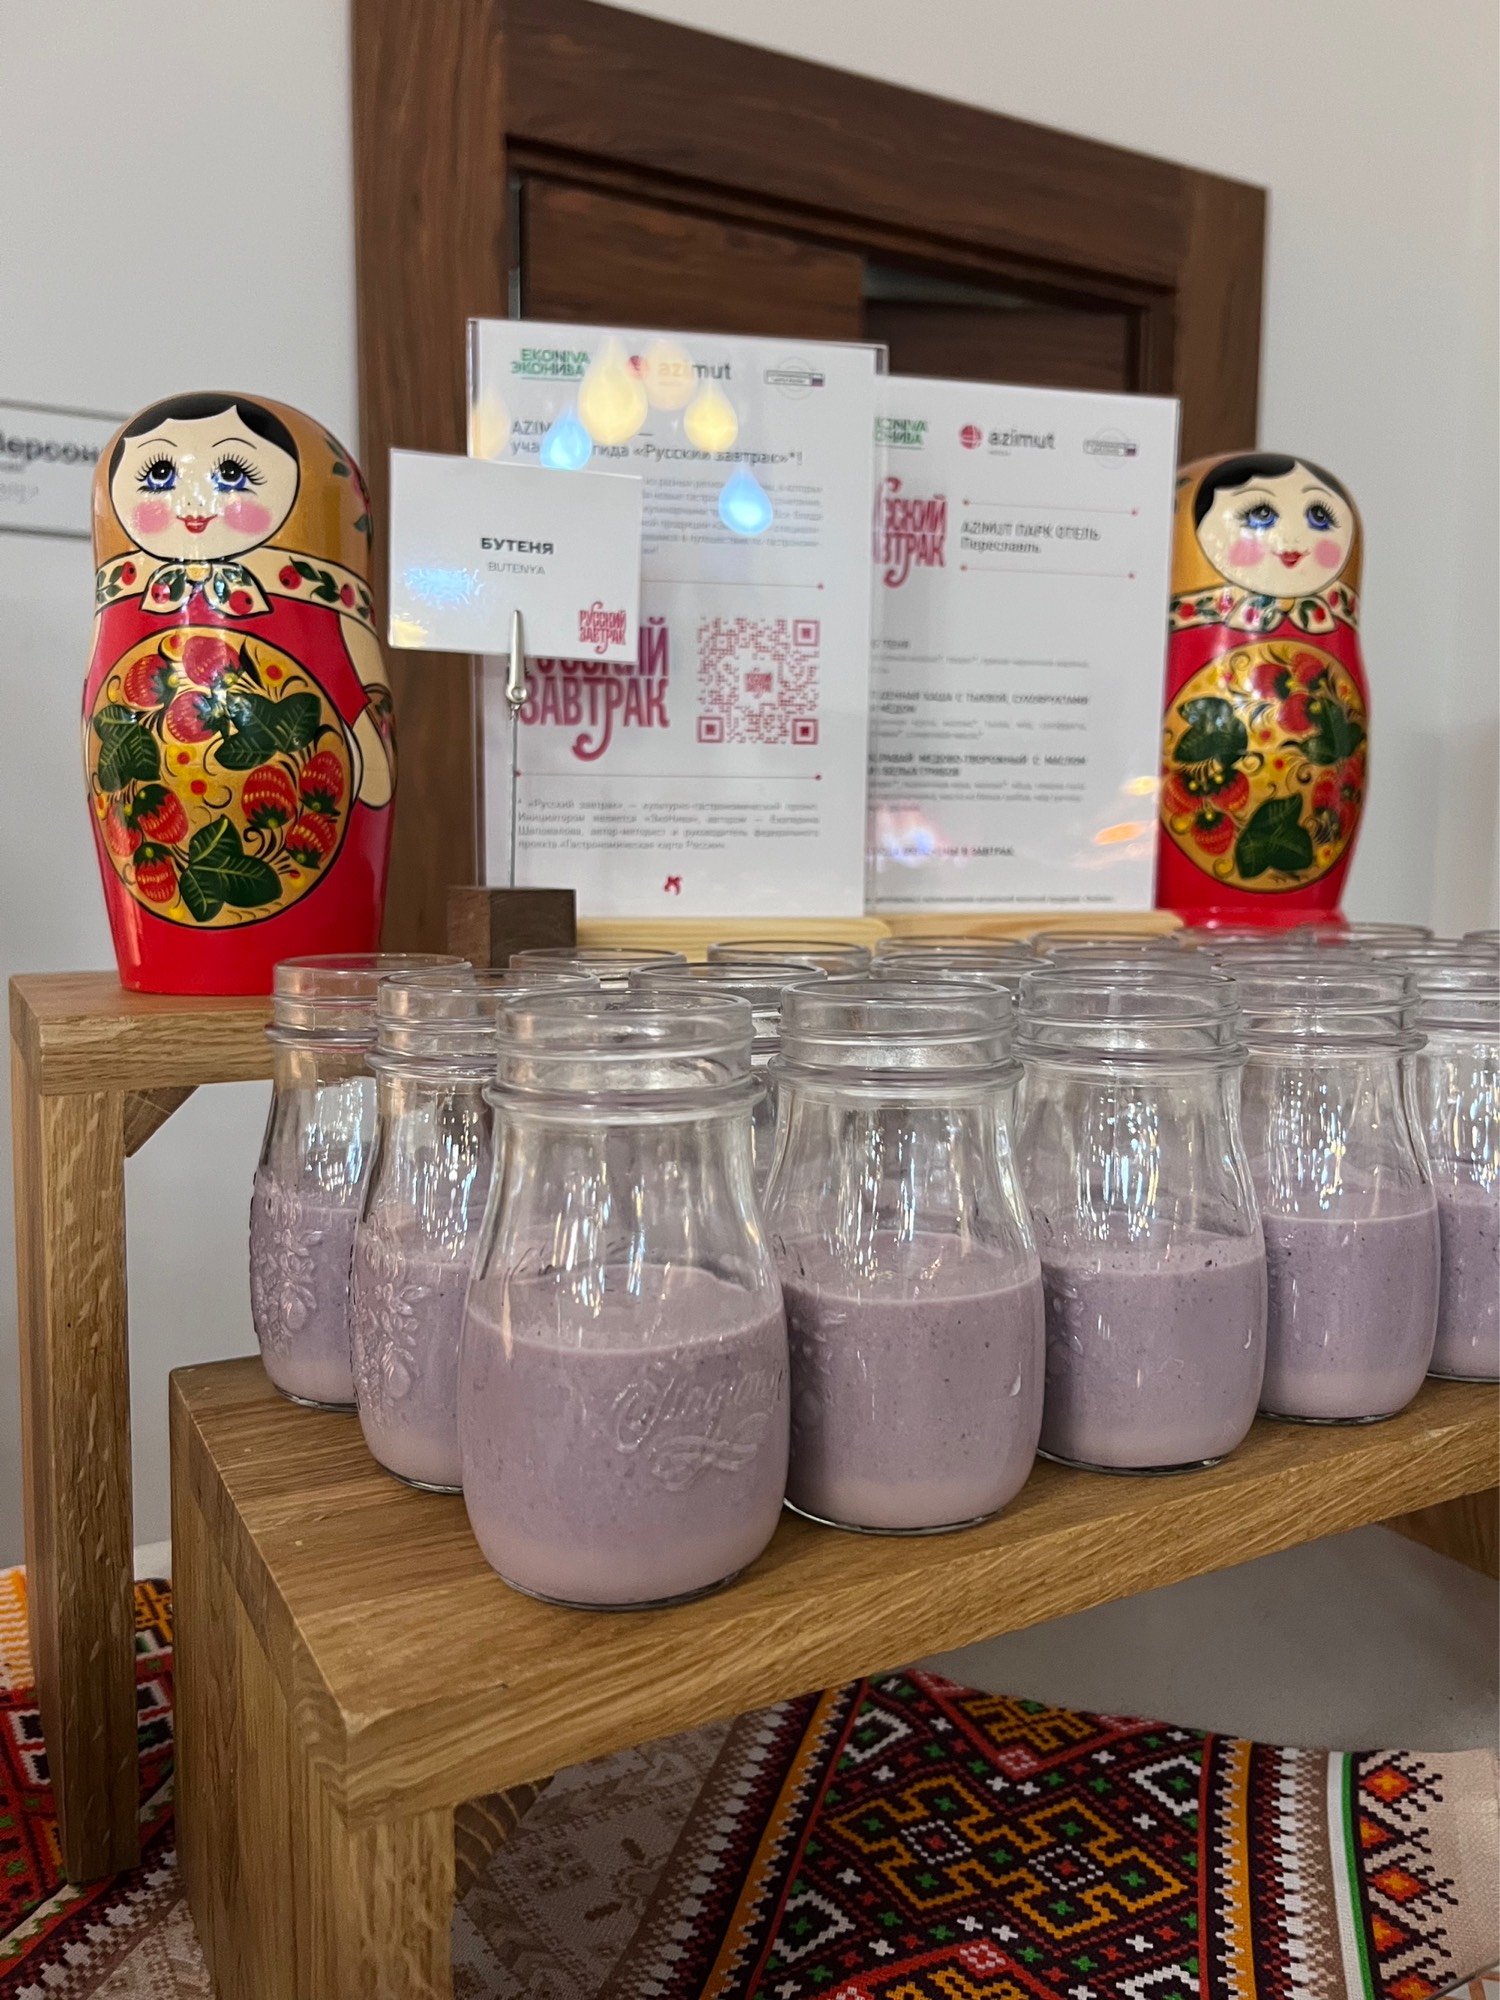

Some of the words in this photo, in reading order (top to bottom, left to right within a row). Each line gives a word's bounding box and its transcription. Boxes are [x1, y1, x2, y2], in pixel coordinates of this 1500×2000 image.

[521, 348, 591, 364] EKONIVA
[511, 361, 585, 377] ЭКОНИВА
[988, 426, 1056, 450] azimut
[481, 537, 555, 555] БУТЕНЯ
[488, 561, 546, 575] BUTENYA
[579, 627, 627, 655] ЗАВТРАК
[519, 675, 670, 761] ЗАВТРАК
